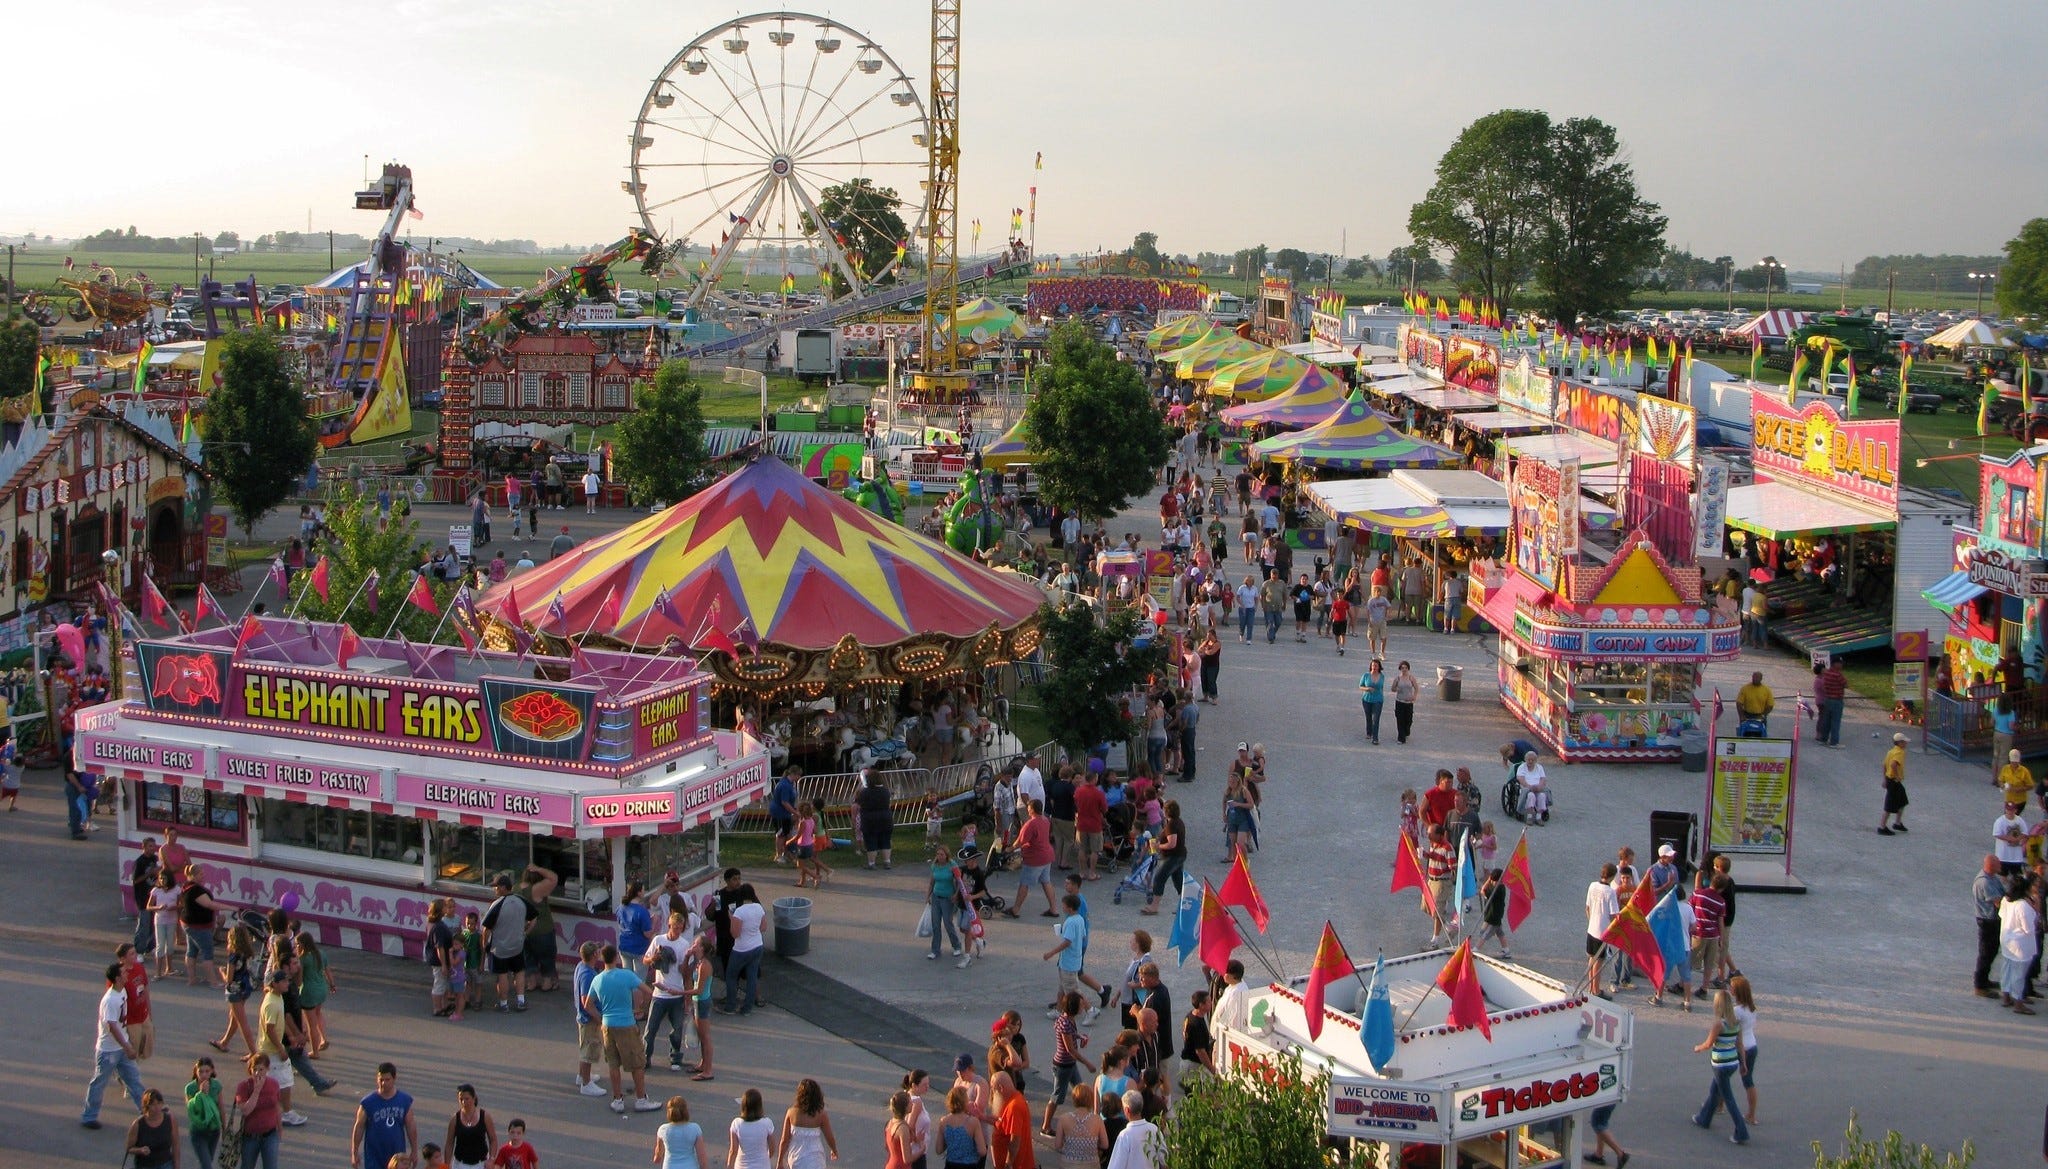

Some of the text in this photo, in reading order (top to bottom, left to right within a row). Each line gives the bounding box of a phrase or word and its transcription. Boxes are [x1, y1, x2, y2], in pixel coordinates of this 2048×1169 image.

[589, 308, 613, 320] PHOTO
[1753, 411, 1894, 486] SKEE BALL
[831, 472, 845, 488] 2
[210, 516, 224, 534] 2
[1153, 552, 1171, 574] 2
[1533, 629, 1582, 651] COLD DRINKS
[1593, 635, 1699, 652] COTTON CANDY
[1900, 632, 1921, 657] 2
[244, 673, 483, 743] ELEPHANT EARS
[639, 690, 691, 729] ELEPHANT
[651, 717, 679, 748] EARS
[94, 740, 194, 771] ELEPHANT EARS
[1719, 760, 1786, 774] SIZE WIZE
[227, 758, 370, 794] SWEET FRIED PASTRY
[686, 763, 763, 811] SWEET FRIED PASTRY
[426, 783, 542, 816] ELEPHANT EARS
[587, 799, 672, 820] COLD DRINKS
[1343, 1086, 1430, 1103] WELCOME TO
[1481, 1072, 1600, 1119] Tickets
[373, 1106, 405, 1122] COLTS
[1335, 1097, 1438, 1122] MID-AMERICA
[1361, 1119, 1414, 1130] SHOWS
